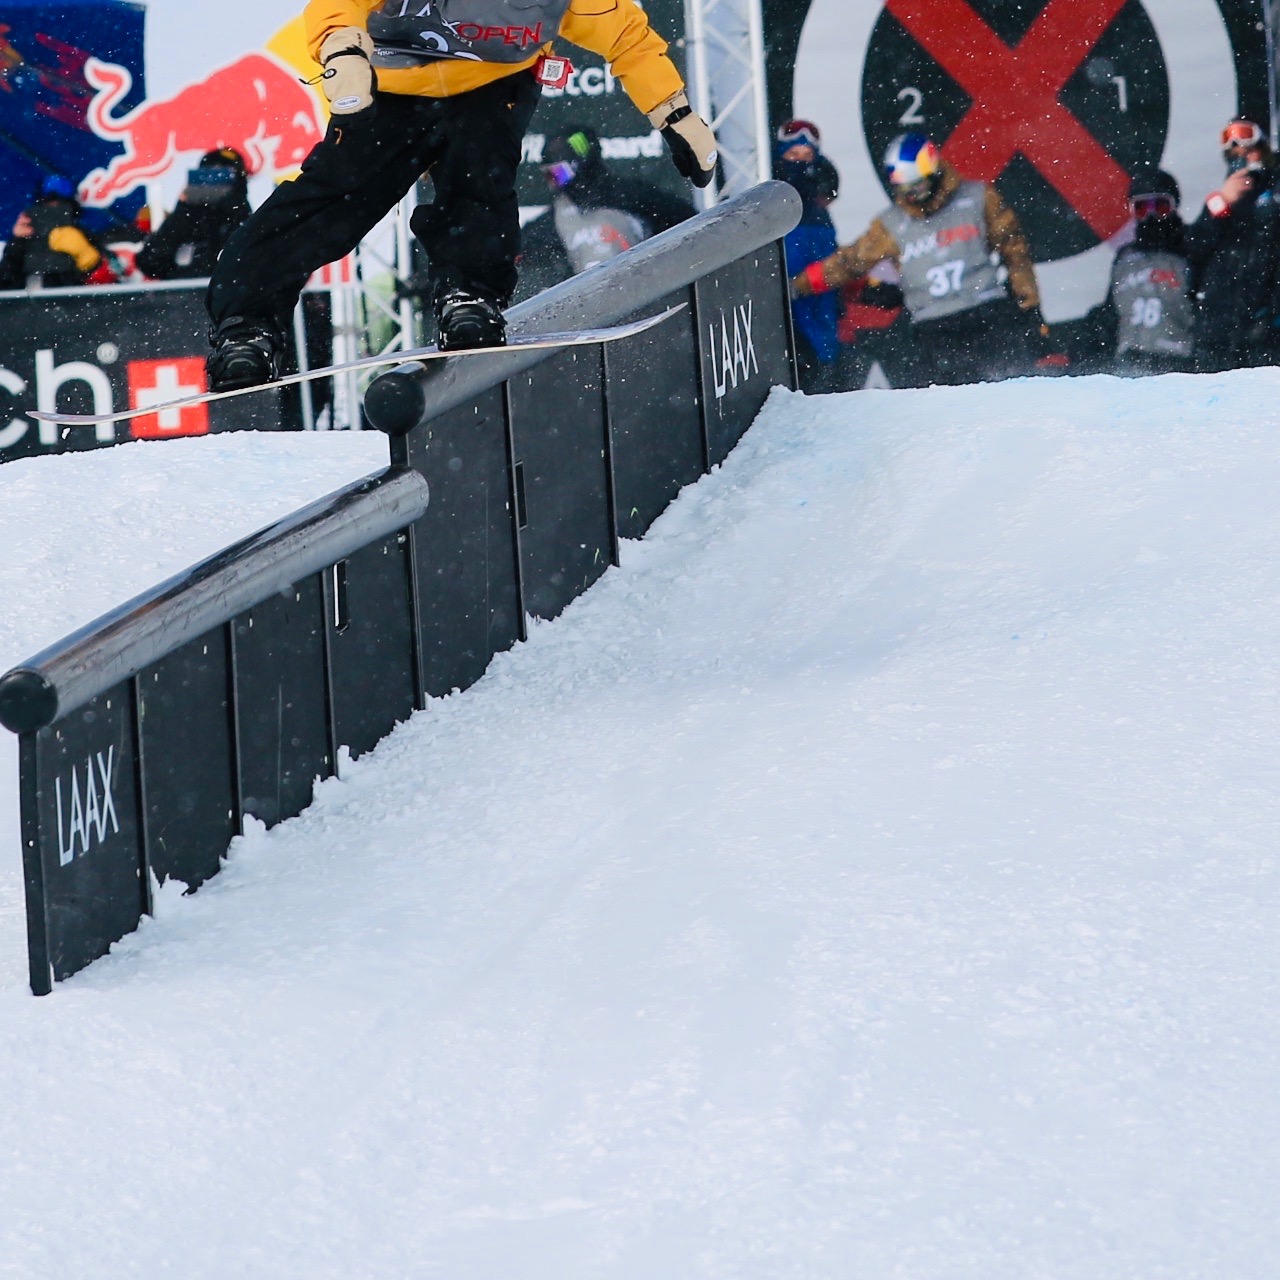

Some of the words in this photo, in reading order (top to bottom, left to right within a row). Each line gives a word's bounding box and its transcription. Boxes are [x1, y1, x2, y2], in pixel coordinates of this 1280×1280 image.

[457, 22, 542, 47] OPEN
[897, 86, 925, 125] 2
[1111, 76, 1128, 112] 1
[925, 259, 965, 297] 37
[709, 299, 760, 399] LAAX
[55, 743, 120, 868] LAAX
